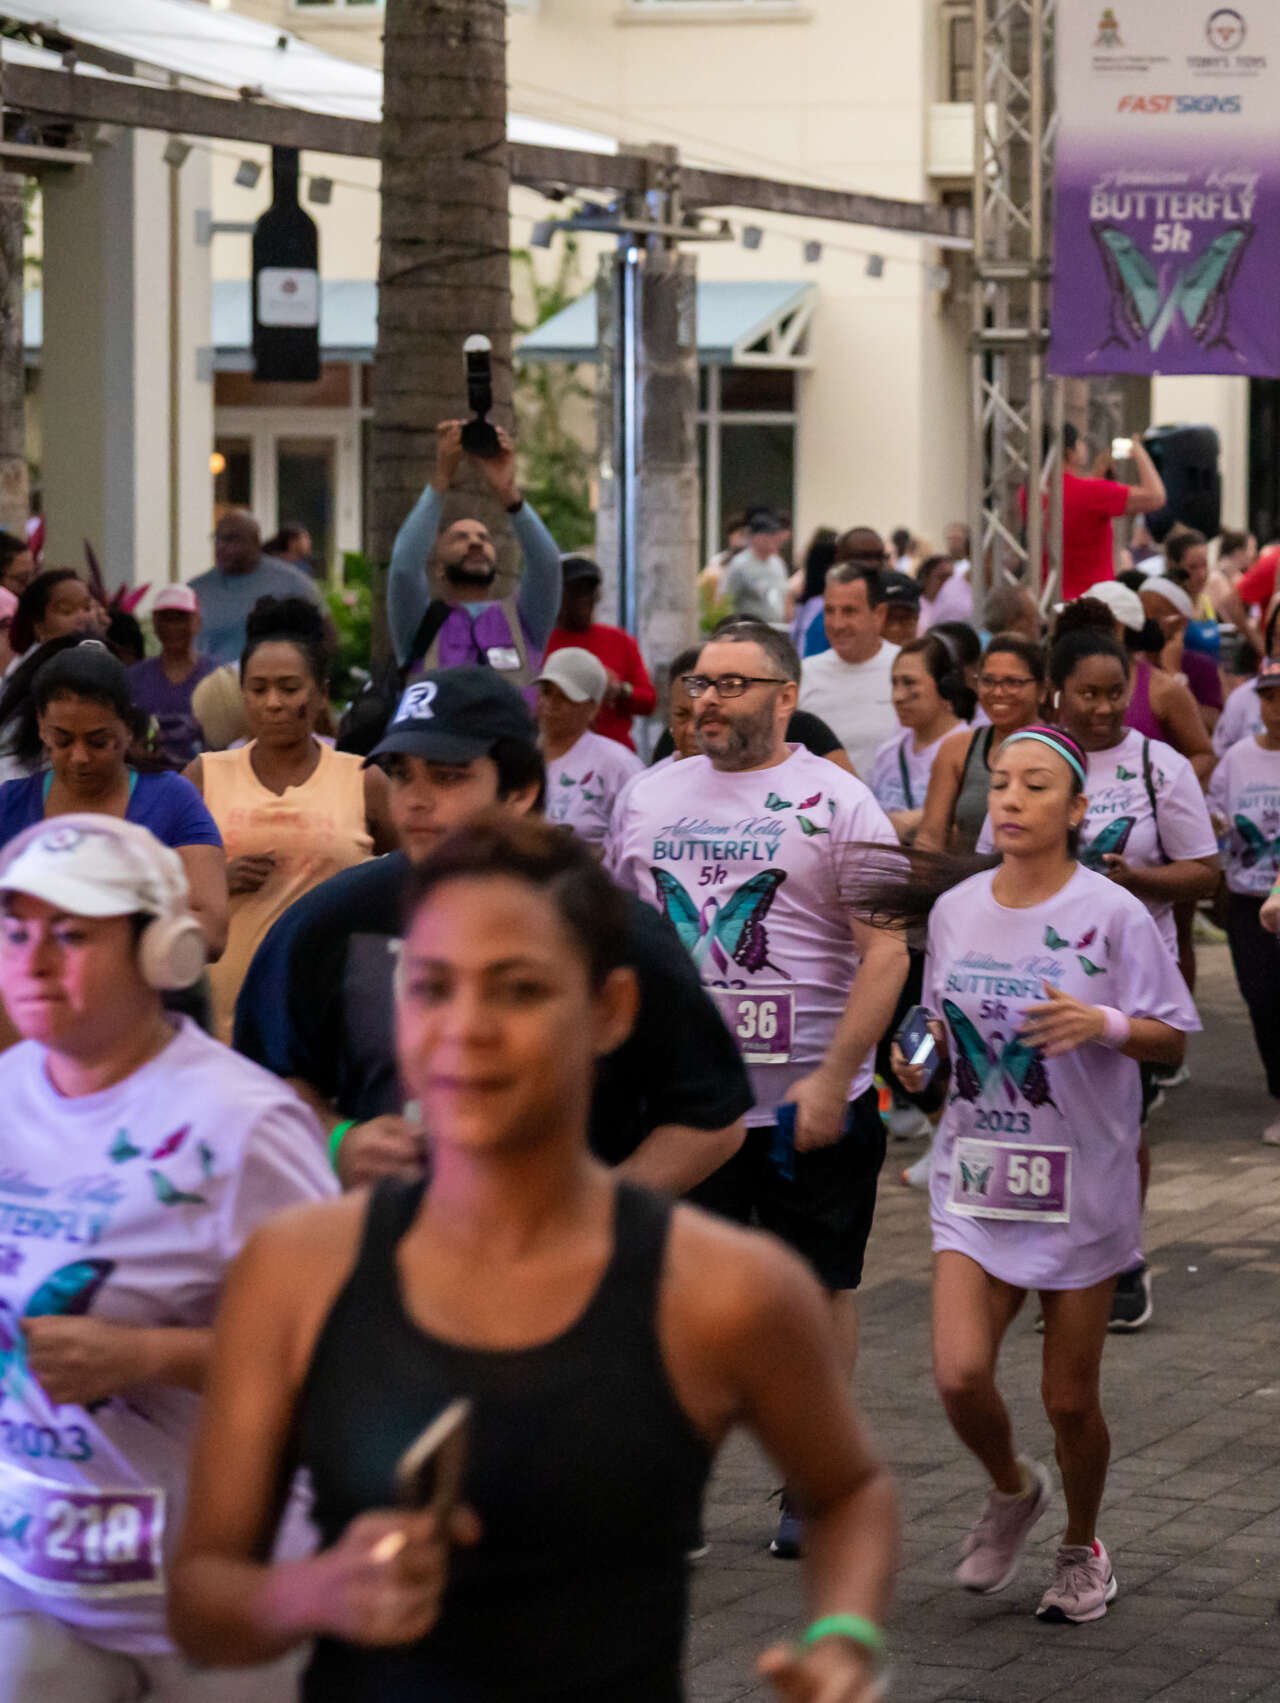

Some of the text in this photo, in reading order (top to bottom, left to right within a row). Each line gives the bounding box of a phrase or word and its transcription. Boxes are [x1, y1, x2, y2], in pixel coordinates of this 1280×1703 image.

[1117, 94, 1242, 114] FASTSIGNS
[1090, 192, 1255, 220] BUTTERFLY
[652, 816, 788, 842] Addison Kelly
[652, 840, 781, 861] BUTTERFLY
[945, 973, 1048, 1000] BUTTERFL
[736, 1000, 778, 1039] 36
[974, 1108, 1031, 1134] 2023
[1007, 1154, 1051, 1197] 58
